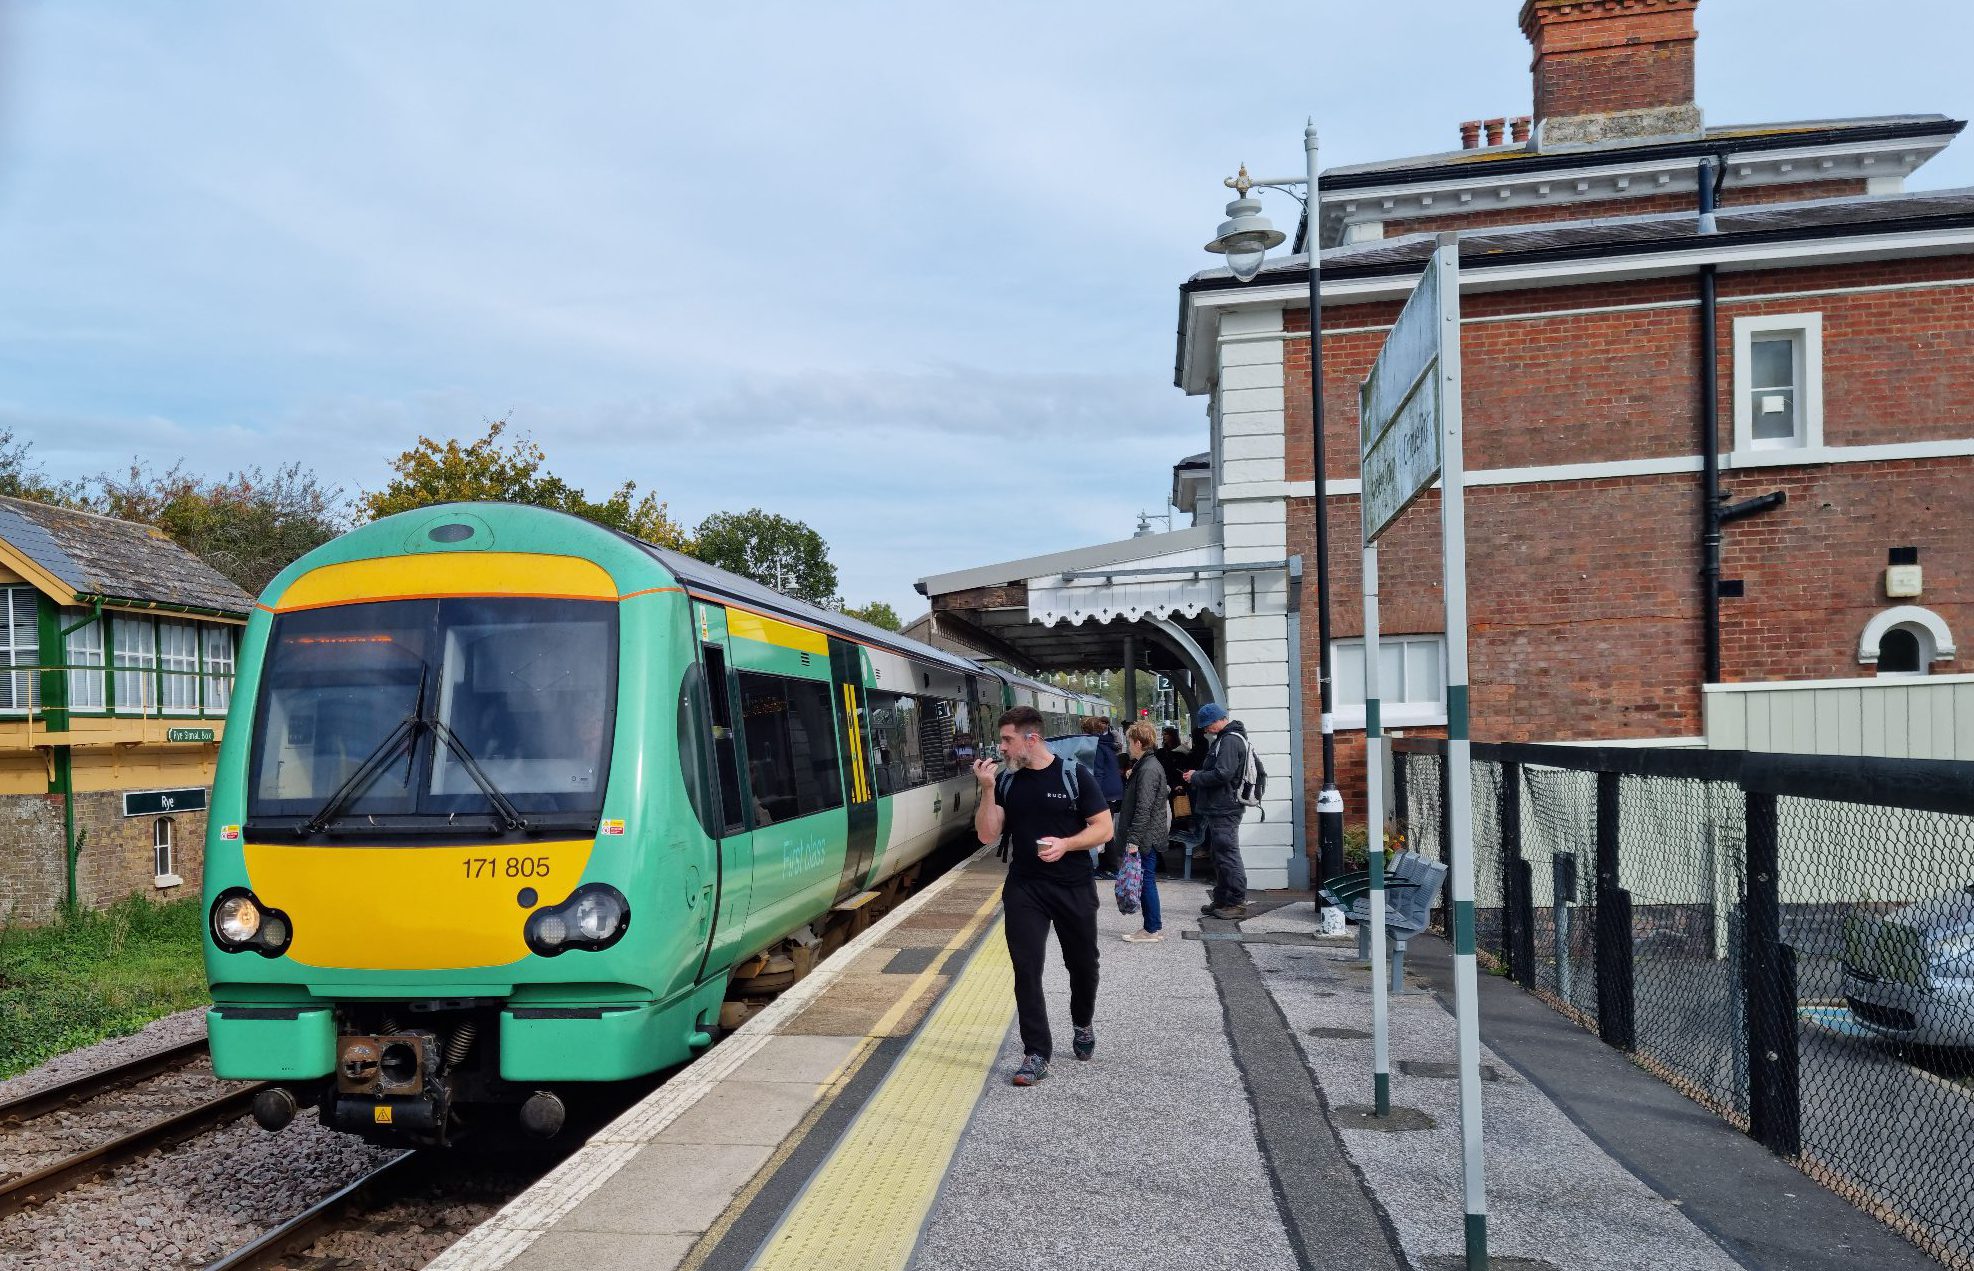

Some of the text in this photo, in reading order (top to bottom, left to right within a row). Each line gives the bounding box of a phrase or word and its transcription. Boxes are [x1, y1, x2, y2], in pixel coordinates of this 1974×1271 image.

[1162, 677, 1170, 688] 2
[161, 795, 175, 811] Rye
[462, 856, 550, 878] 171 805
